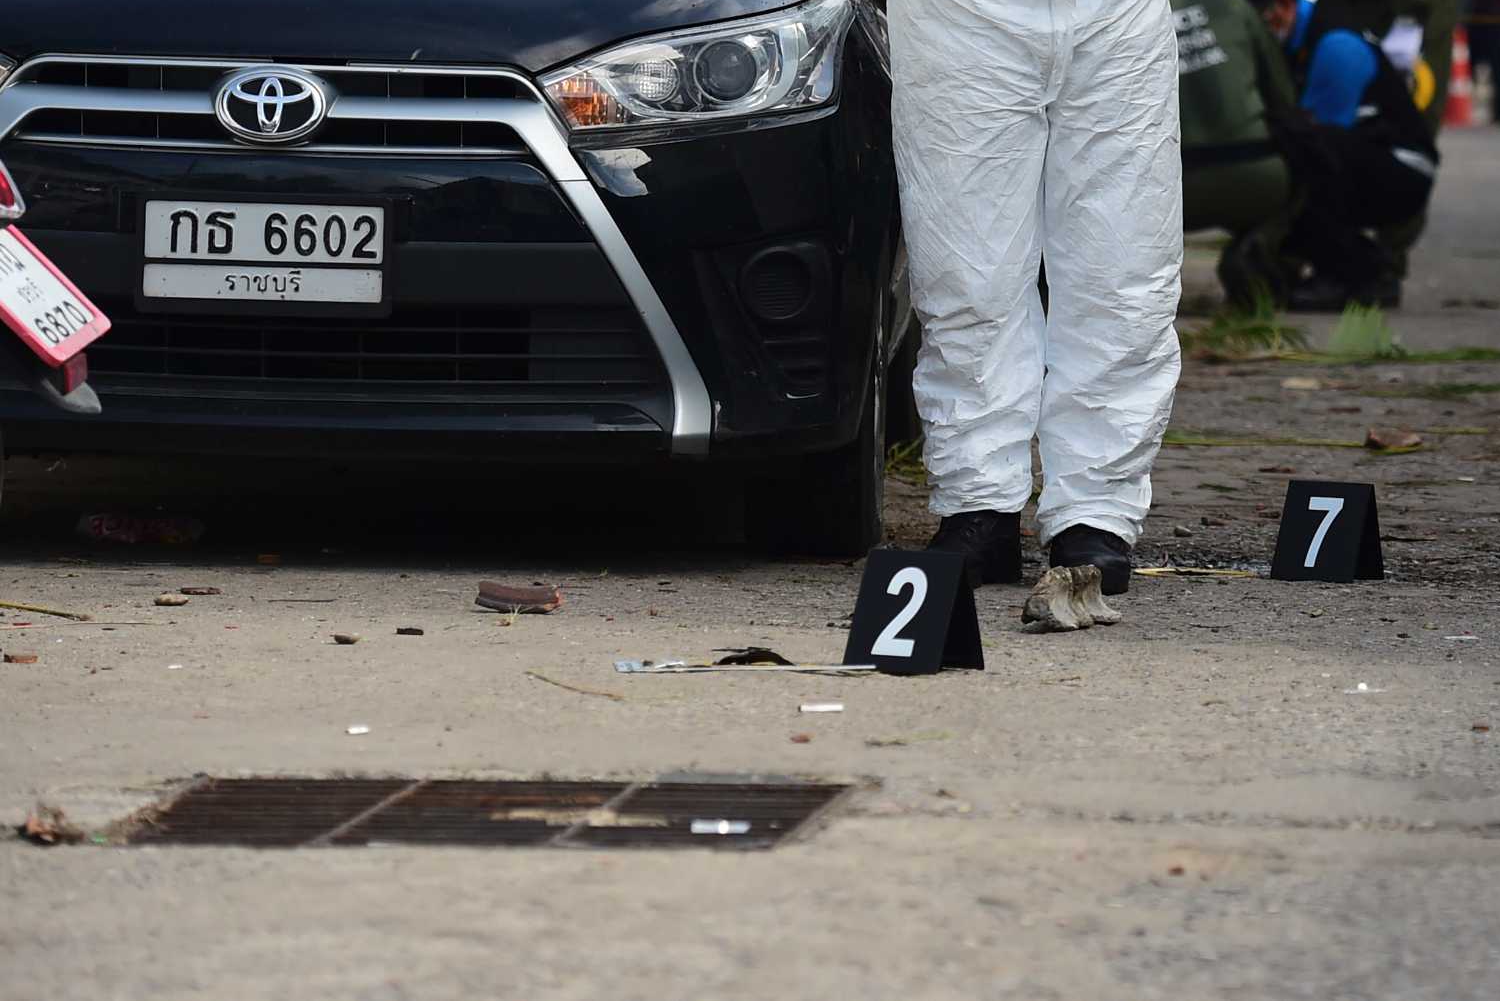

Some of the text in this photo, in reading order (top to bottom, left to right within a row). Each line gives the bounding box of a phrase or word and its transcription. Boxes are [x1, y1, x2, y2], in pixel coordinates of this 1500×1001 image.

[170, 209, 378, 259] กธ 6602
[225, 270, 302, 300] ราชบุรี
[33, 300, 89, 345] 6870
[1303, 496, 1345, 568] 7
[870, 566, 929, 658] 2
